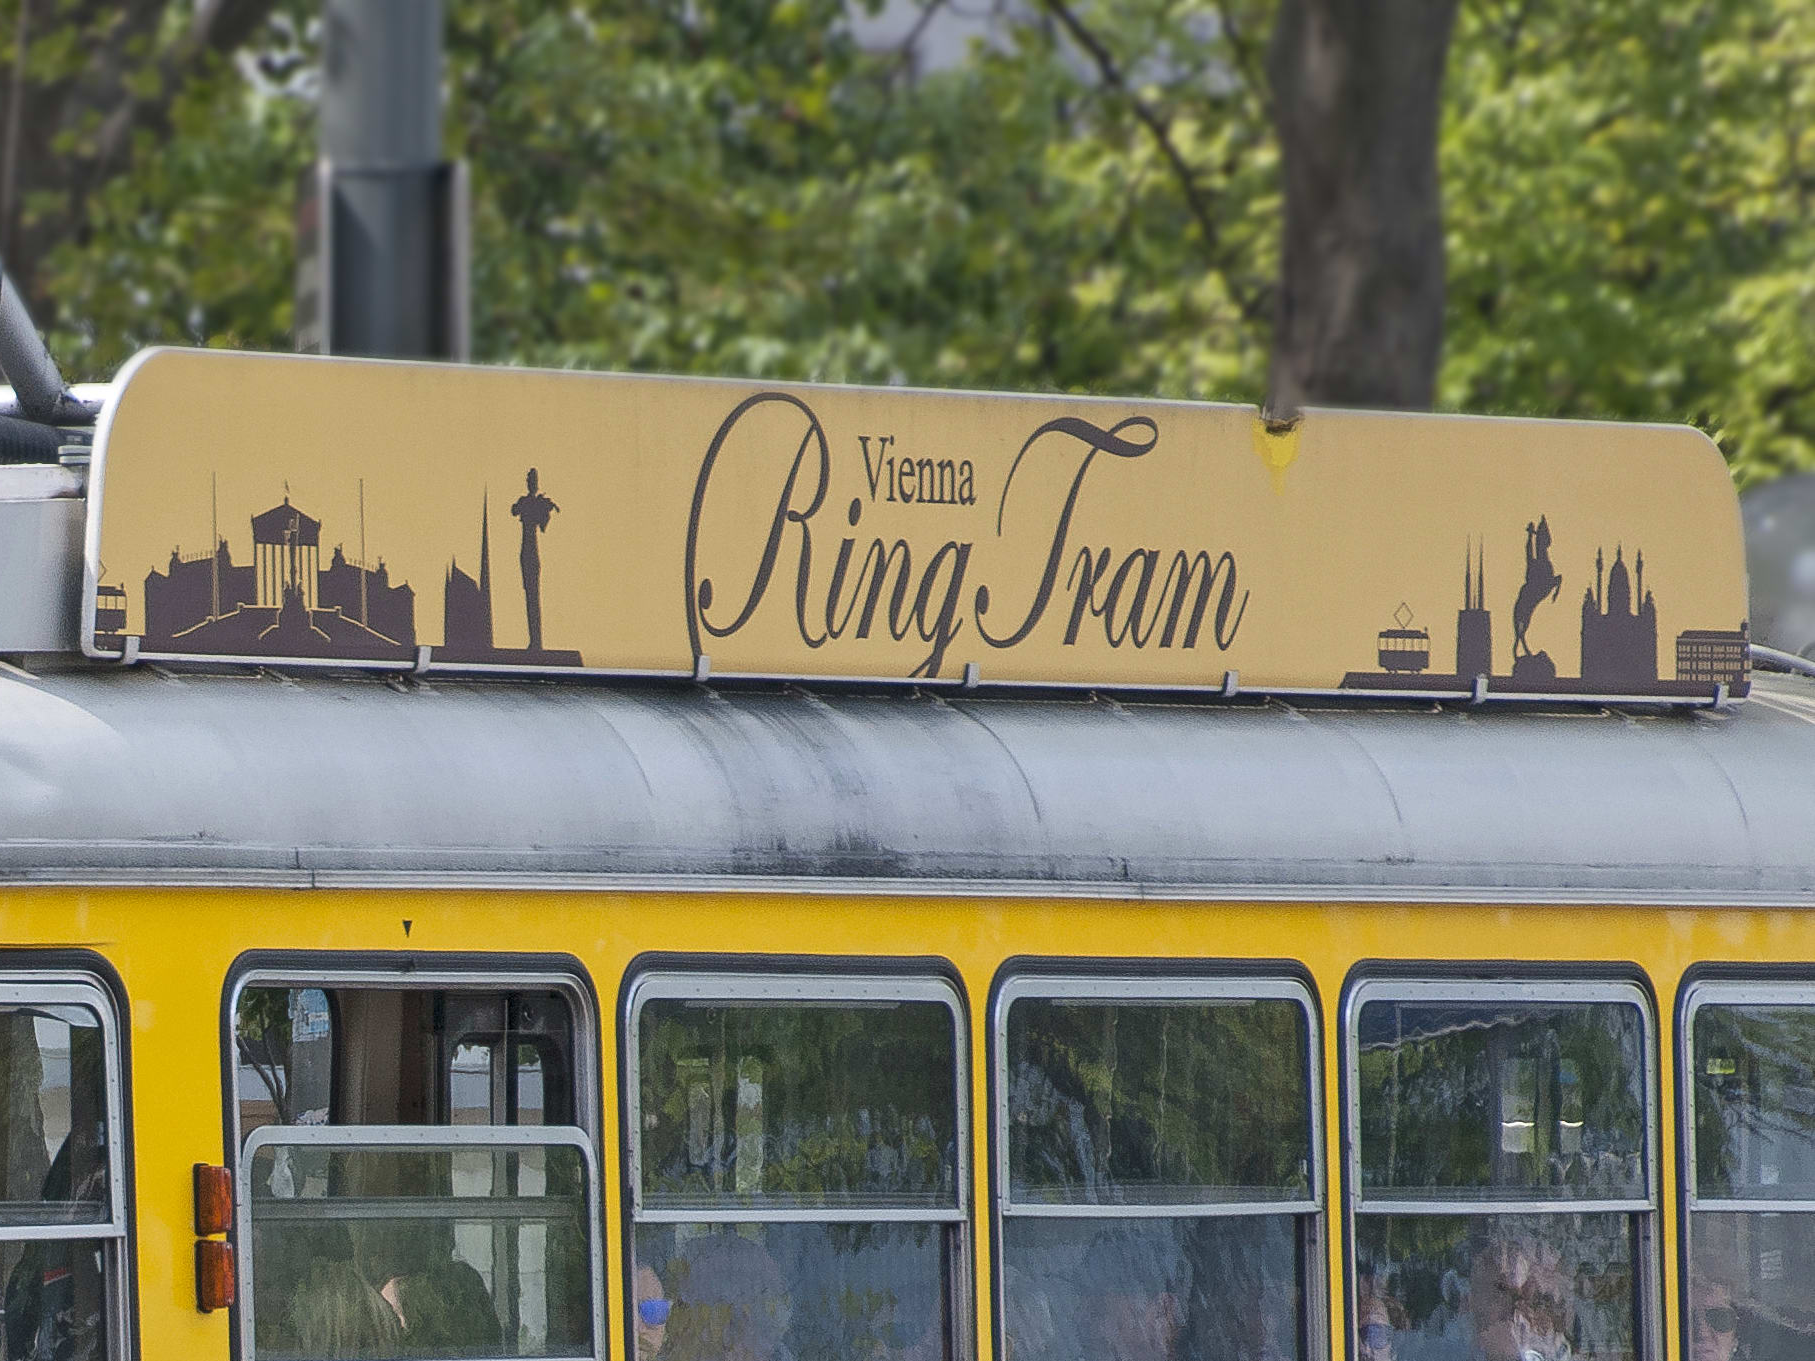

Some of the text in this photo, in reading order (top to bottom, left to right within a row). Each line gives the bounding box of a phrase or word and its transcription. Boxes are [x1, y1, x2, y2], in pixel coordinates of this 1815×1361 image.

[685, 391, 1250, 679] Ring Tram
[858, 434, 976, 506] Vienna
